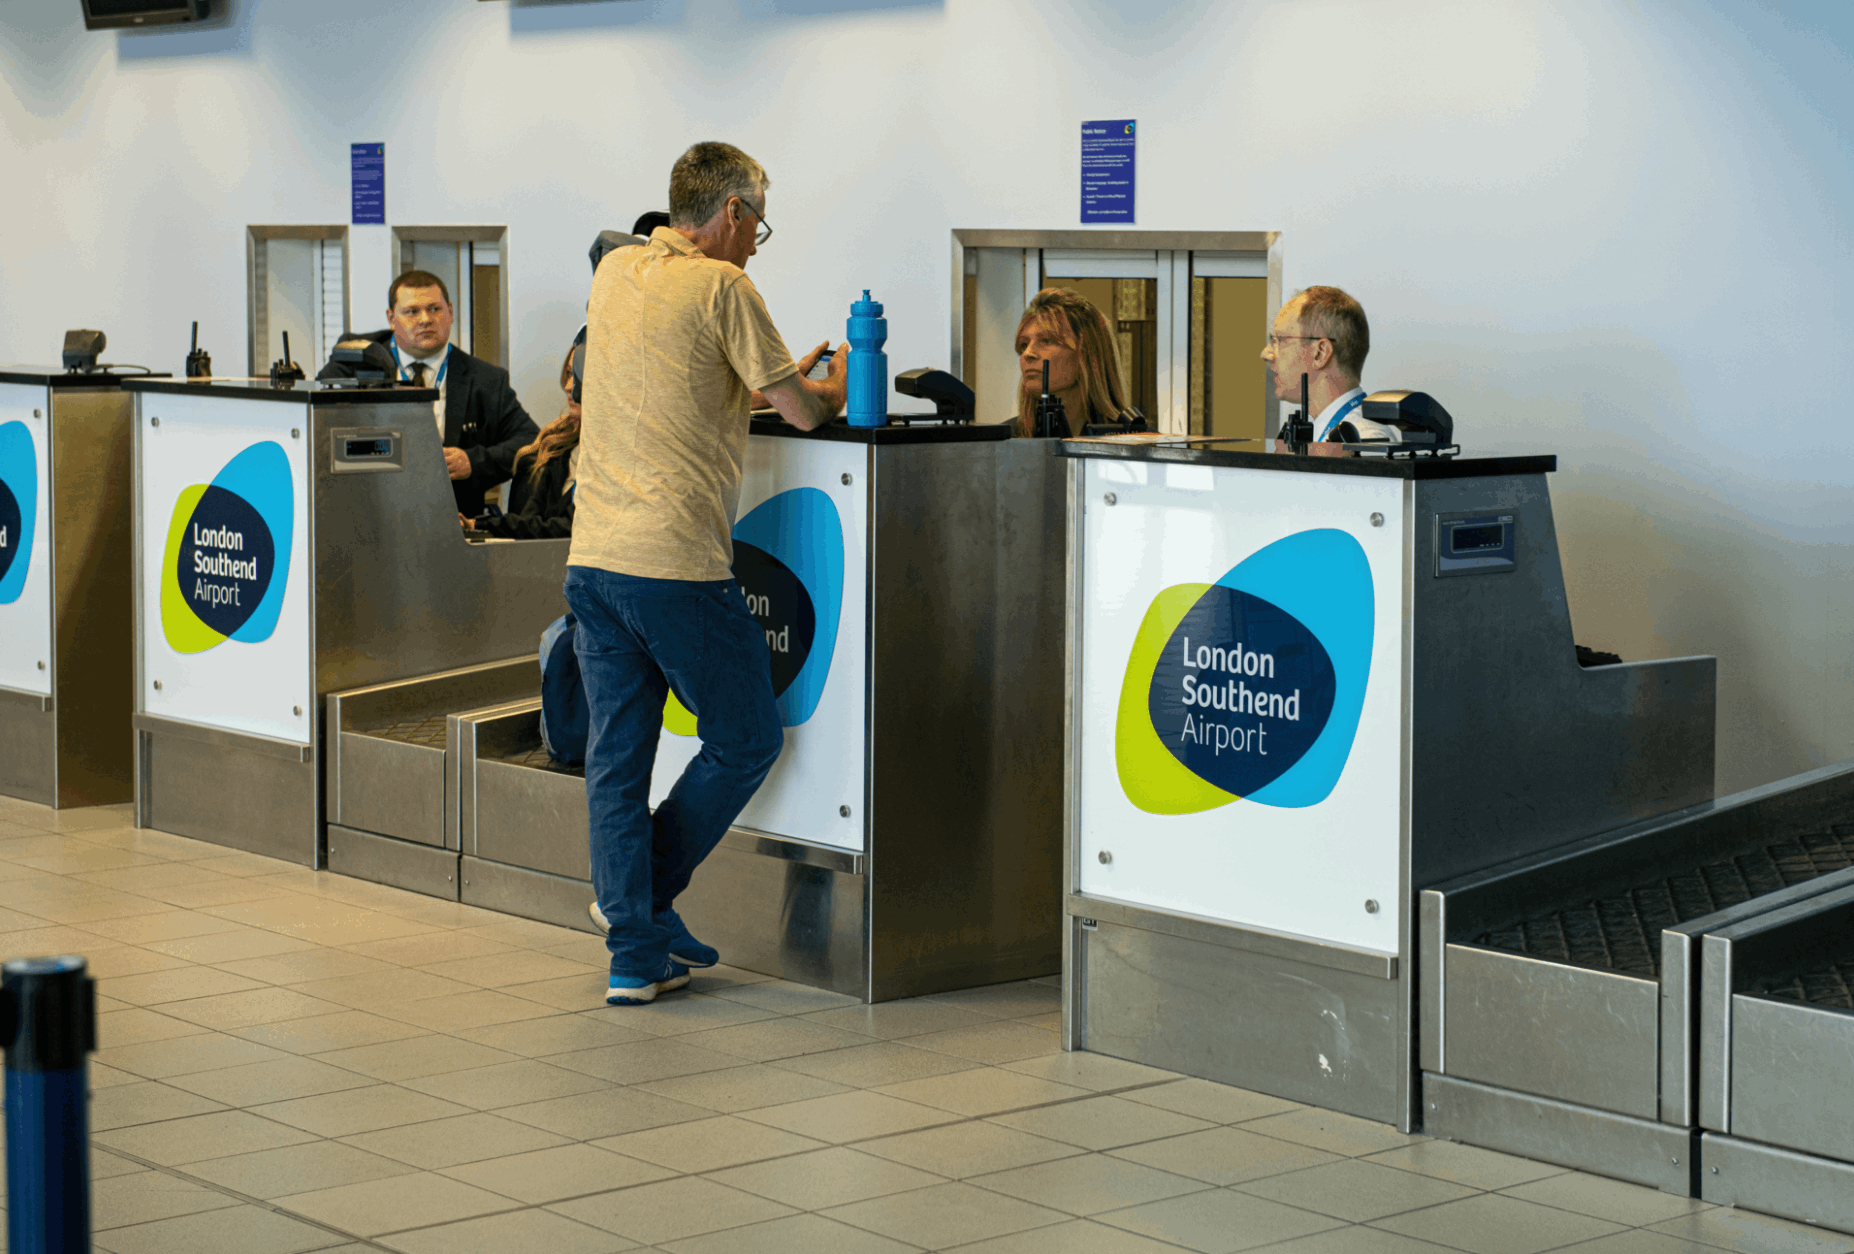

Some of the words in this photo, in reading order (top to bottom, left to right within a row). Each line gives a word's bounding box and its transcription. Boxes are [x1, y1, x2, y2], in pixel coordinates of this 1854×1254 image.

[194, 522, 243, 551] London
[194, 550, 257, 580] Southend
[194, 578, 241, 608] Airport
[1183, 636, 1275, 678] London
[1181, 674, 1300, 721] Southend
[1181, 713, 1268, 756] Airport
